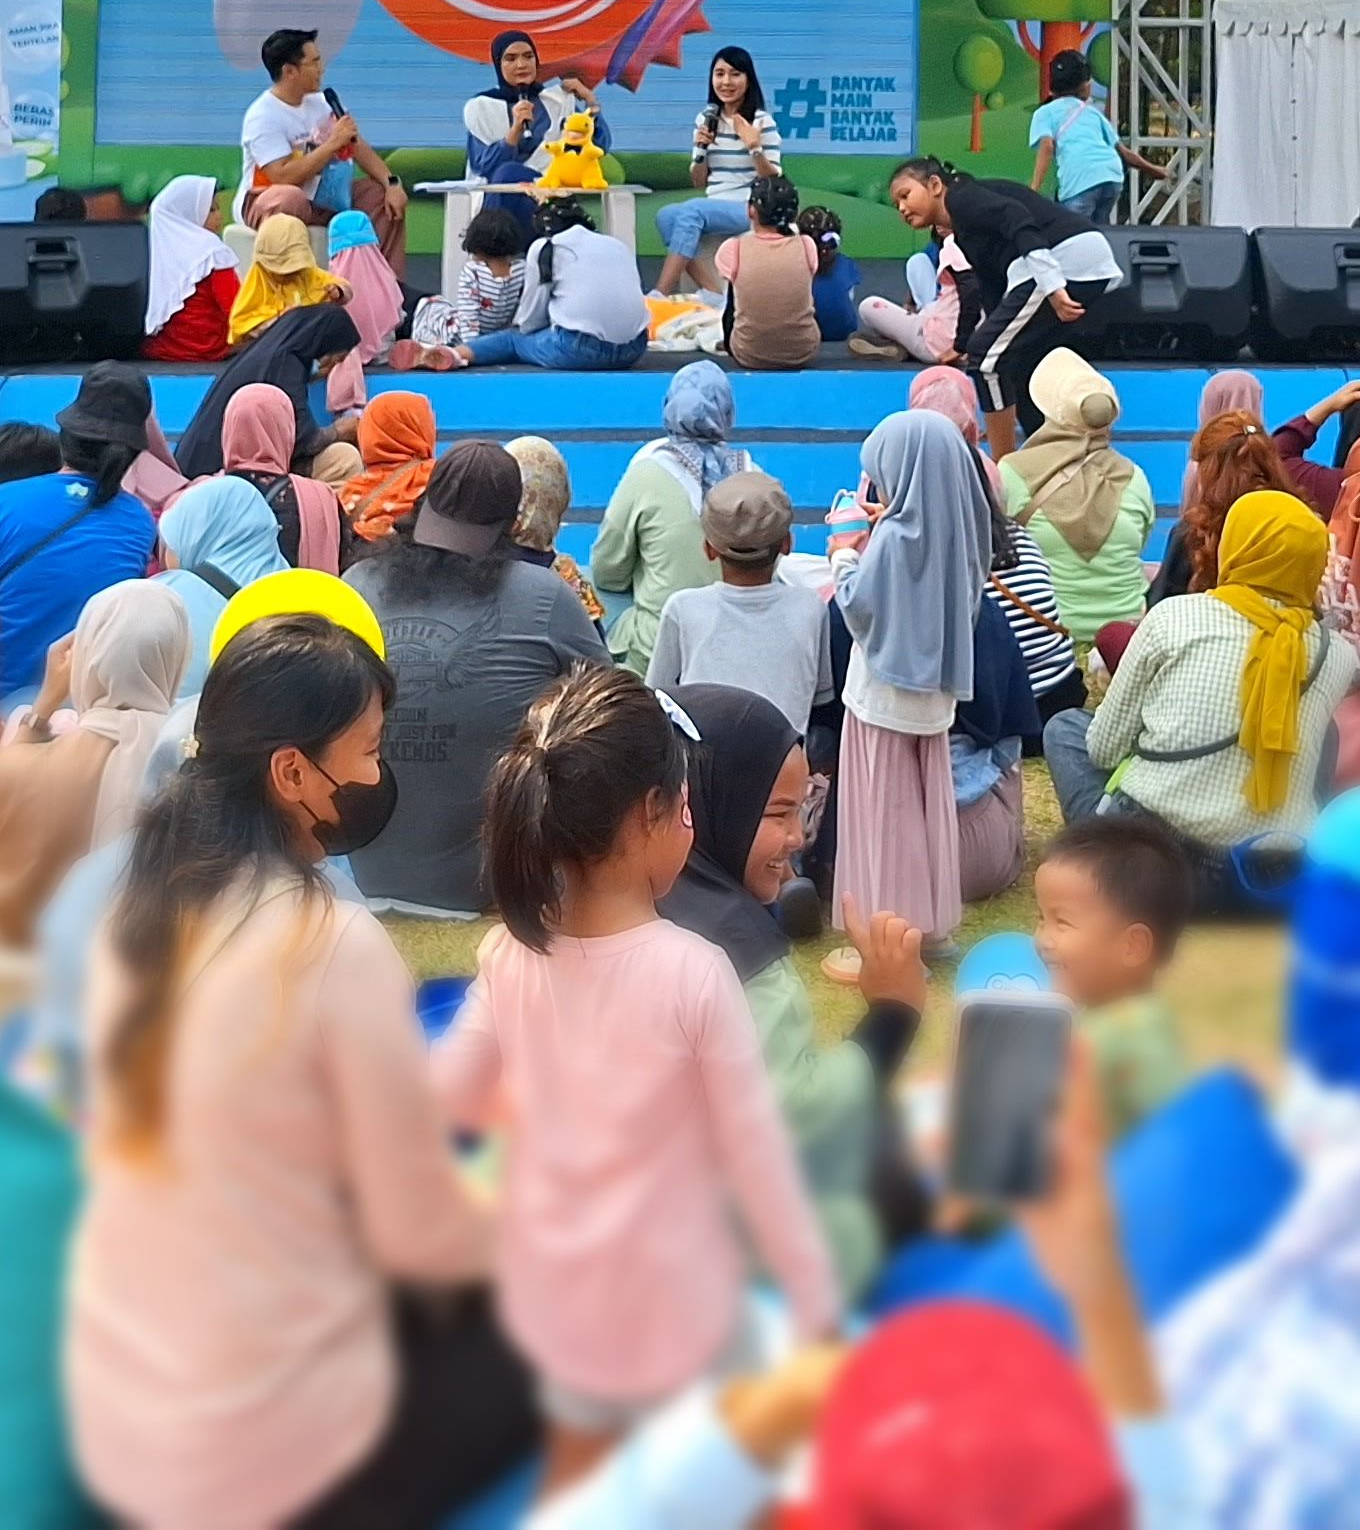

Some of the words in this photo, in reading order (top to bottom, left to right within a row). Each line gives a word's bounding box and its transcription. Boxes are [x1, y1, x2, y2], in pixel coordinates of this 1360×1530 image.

[830, 75, 896, 92] BANYAK
[830, 93, 872, 108] MAIN
[830, 109, 896, 126] BANYAK
[830, 126, 897, 142] BELAJAR
